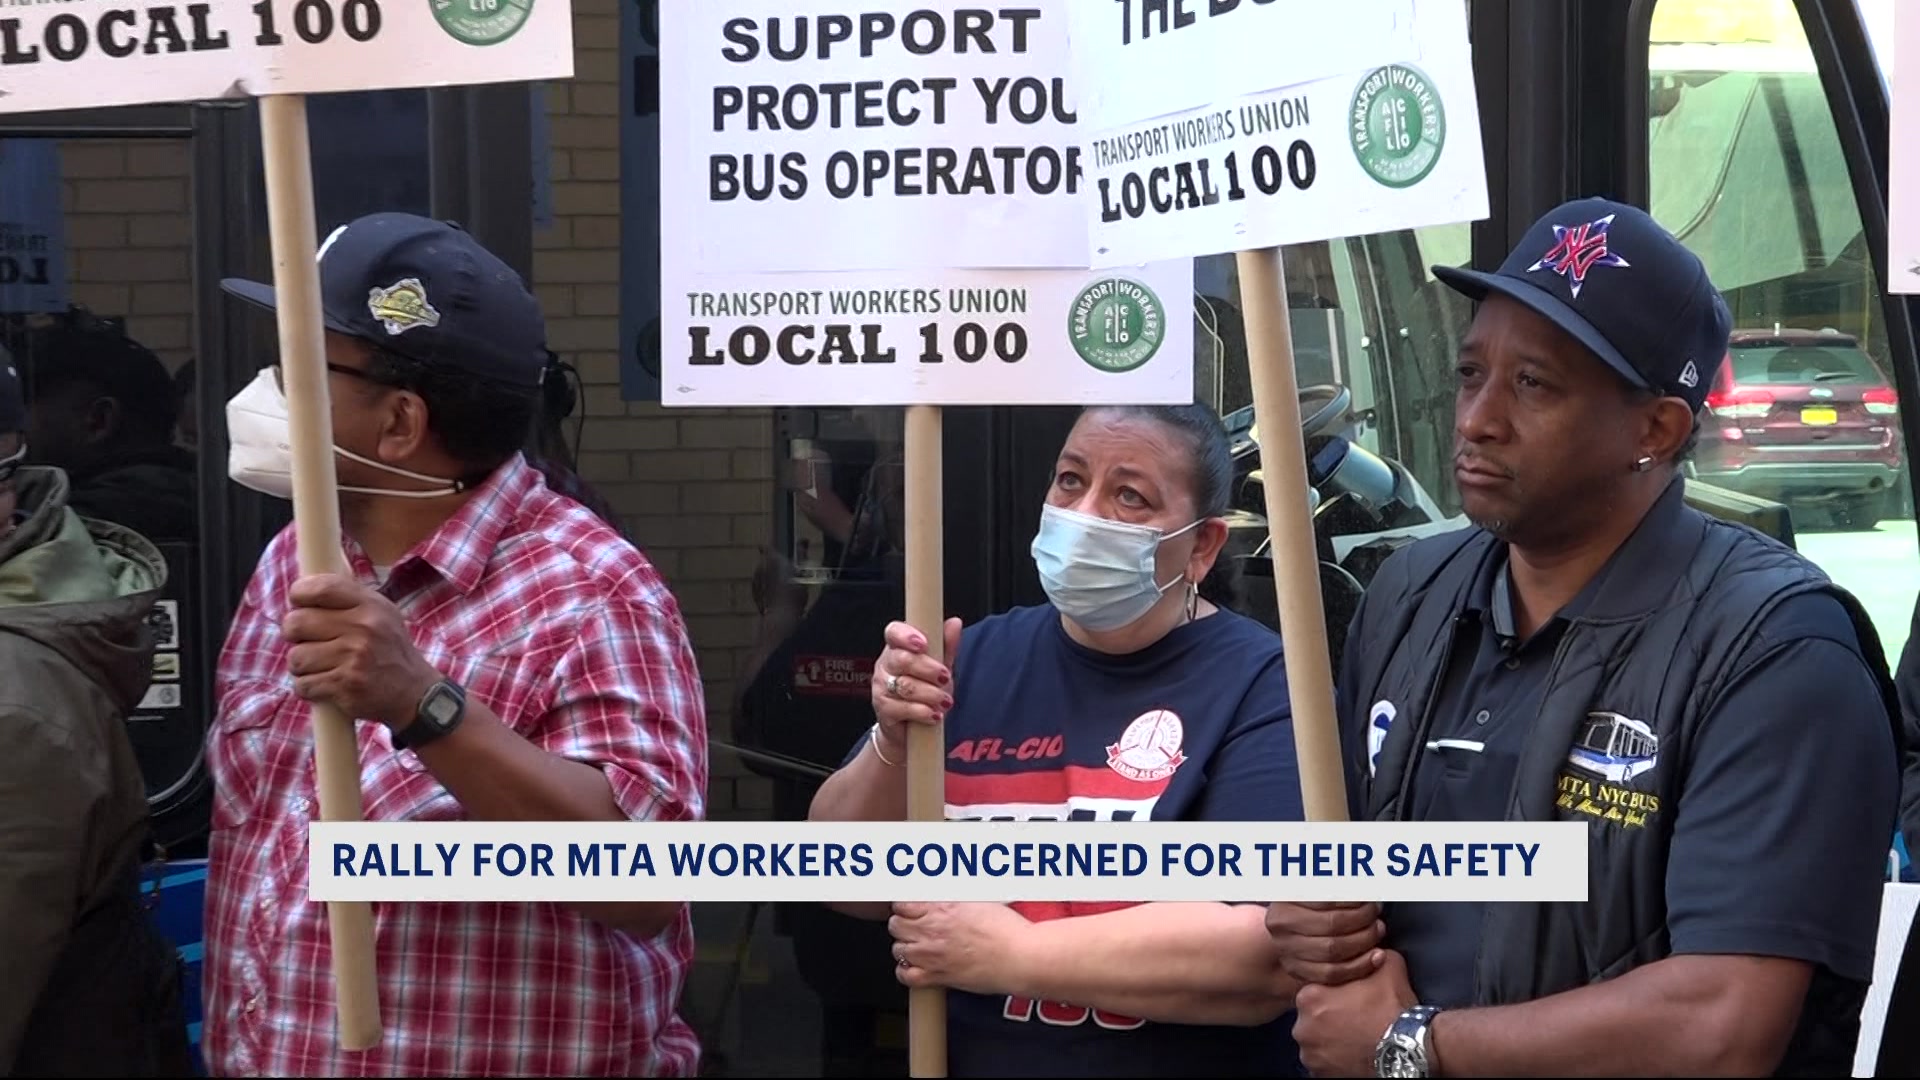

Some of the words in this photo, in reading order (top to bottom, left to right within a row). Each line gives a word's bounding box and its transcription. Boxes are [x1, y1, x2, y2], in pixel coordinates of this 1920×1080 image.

[0, 4, 229, 65] LOCAL
[252, 0, 382, 46] 100
[721, 8, 1041, 62] SUPPORT
[713, 77, 957, 131] PROTECT
[1355, 70, 1388, 151] TRANSPORT
[1392, 69, 1438, 137] WORKERS
[1093, 126, 1169, 169] TRANSPORT
[1172, 110, 1236, 151] WORKERS
[1240, 96, 1310, 137] UNION
[709, 152, 808, 201] BUS
[1097, 158, 1220, 222] LOCAL
[1224, 139, 1317, 201] 100
[687, 291, 823, 317] TRANSPORT
[829, 289, 942, 315] WORKERS
[949, 288, 1027, 313] UNION
[688, 324, 896, 365] LOCAL
[919, 322, 1028, 364] 100
[824, 659, 855, 670] FIRE
